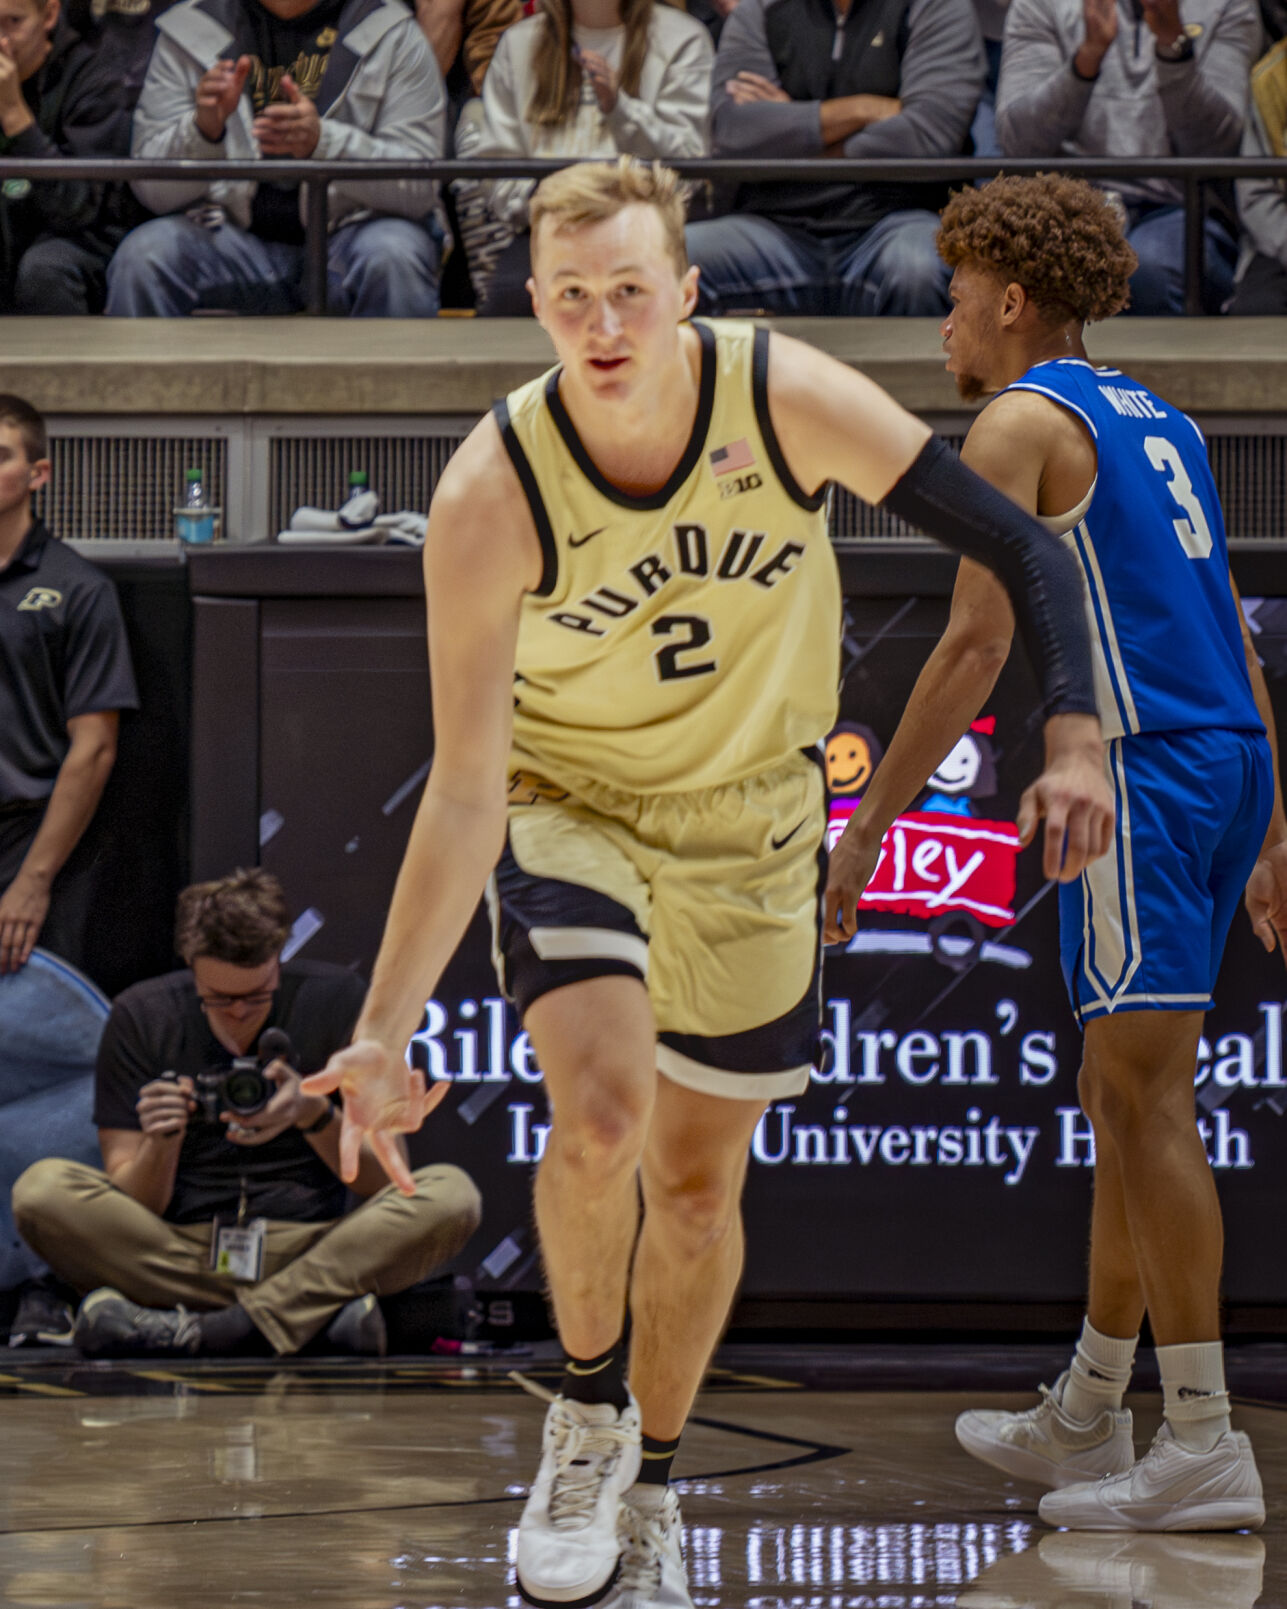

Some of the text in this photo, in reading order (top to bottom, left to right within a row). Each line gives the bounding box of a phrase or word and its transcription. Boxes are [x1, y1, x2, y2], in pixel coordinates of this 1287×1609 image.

[1098, 385, 1168, 419] WHITE
[1143, 435, 1214, 560] 3
[547, 524, 806, 638] PURDUE
[650, 614, 717, 682] 2
[404, 997, 545, 1083] Rile
[809, 998, 1058, 1085] dren's
[751, 1104, 1041, 1185] University
